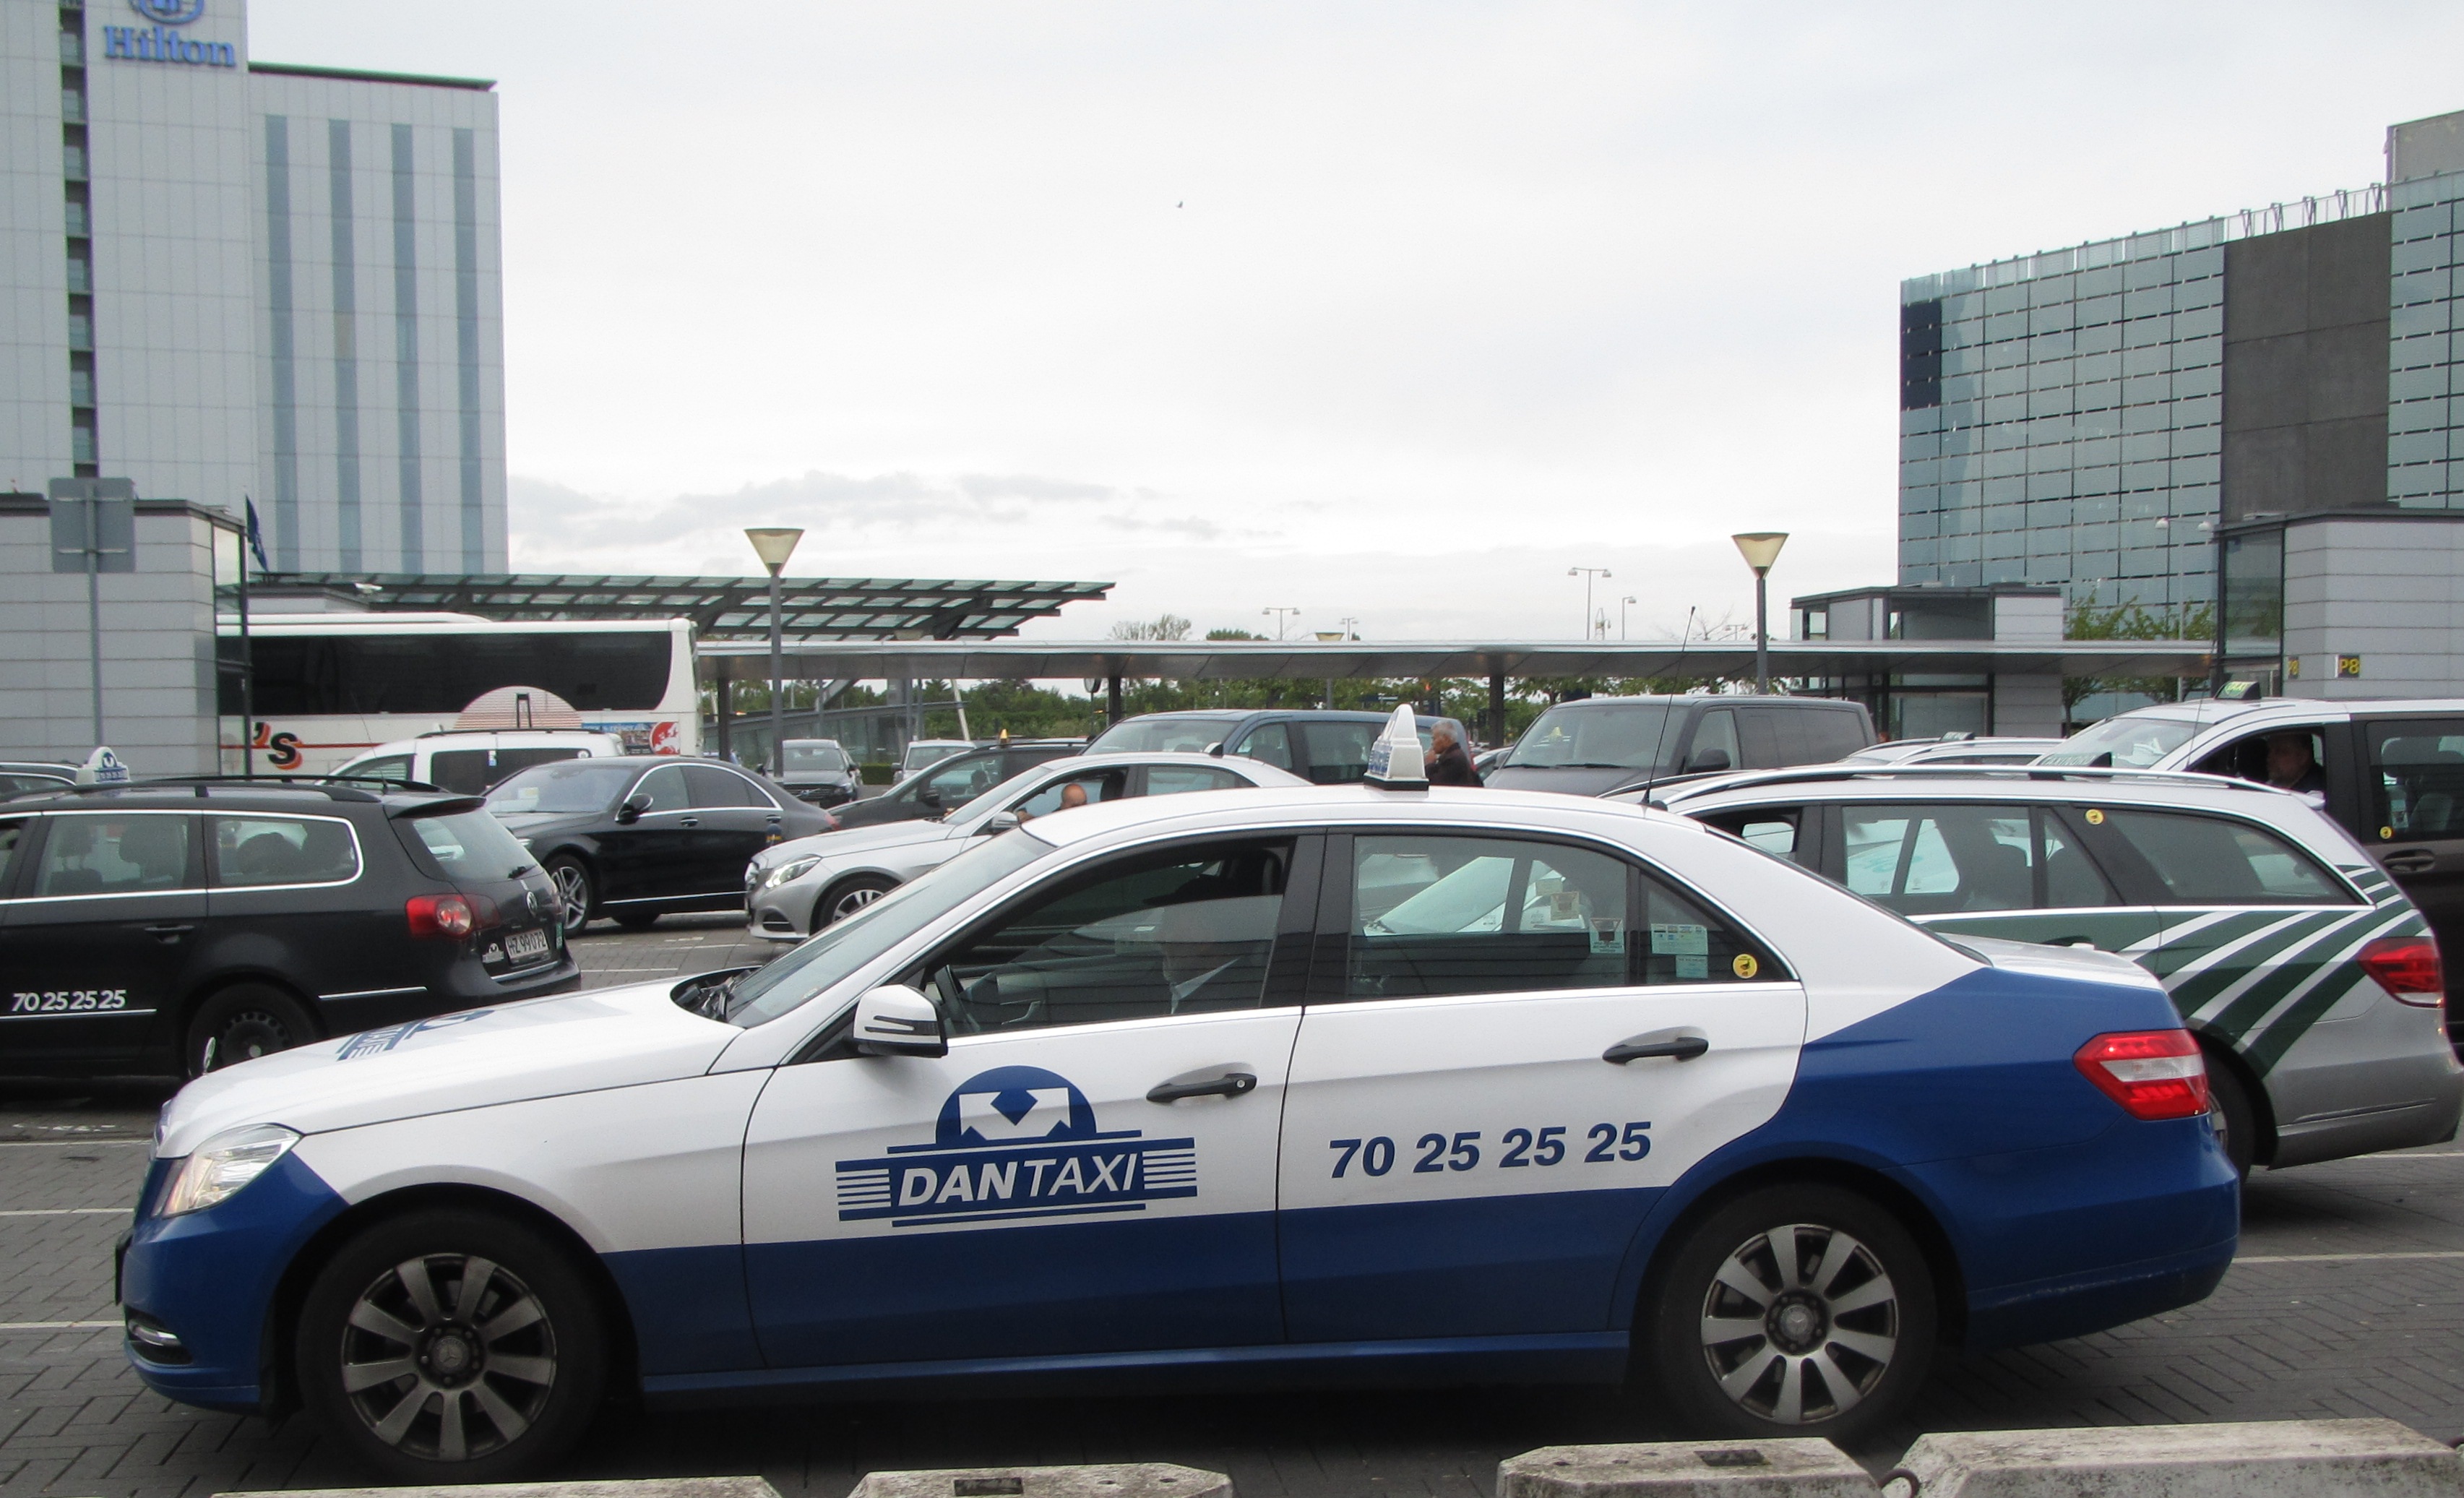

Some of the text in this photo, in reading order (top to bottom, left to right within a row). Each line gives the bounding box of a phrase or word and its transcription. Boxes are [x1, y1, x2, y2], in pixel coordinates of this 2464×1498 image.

[104, 25, 236, 67] Hilton
[2340, 658, 2360, 673] P8
[12, 989, 126, 1012] 70 25 25 25
[1329, 1122, 1652, 1179] 70 25 25 25
[898, 1153, 1137, 1207] DANTAXI
